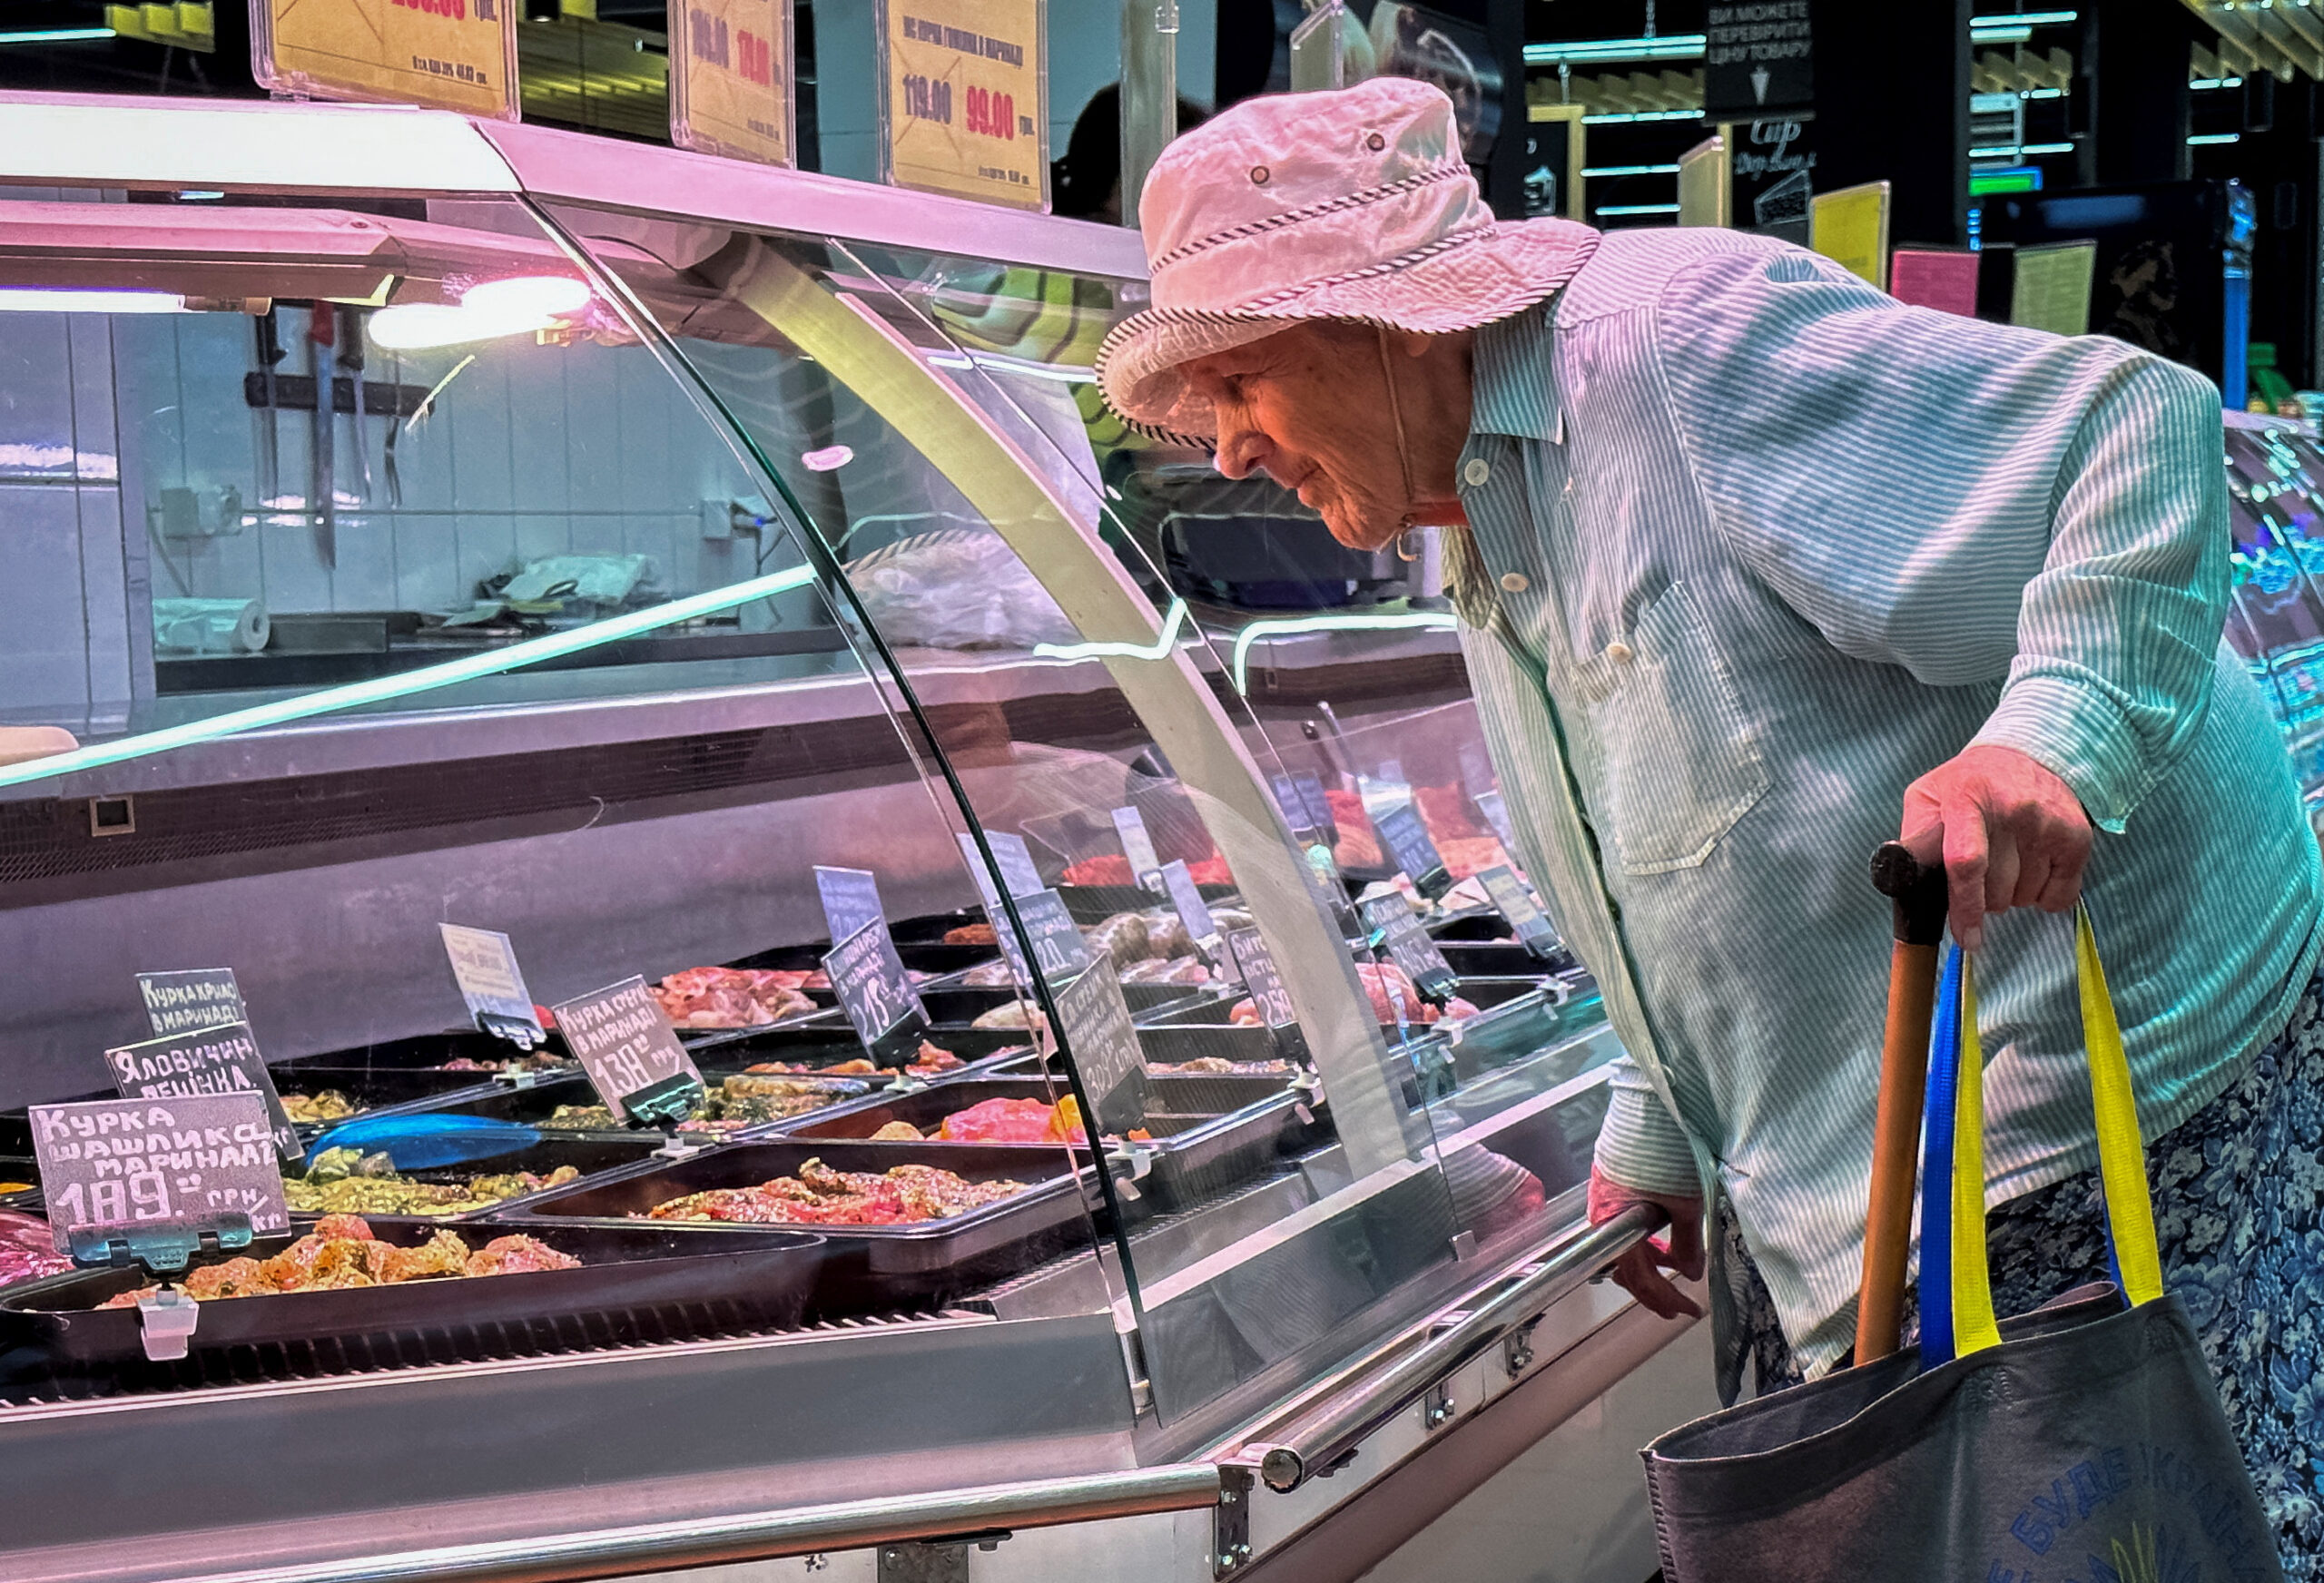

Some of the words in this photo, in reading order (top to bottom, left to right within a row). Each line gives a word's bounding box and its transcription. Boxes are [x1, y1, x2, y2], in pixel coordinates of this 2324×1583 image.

[967, 84, 1014, 141] 99.00
[36, 1106, 175, 1143] КУРКА
[2009, 1446, 2133, 1555] БУДЕ
